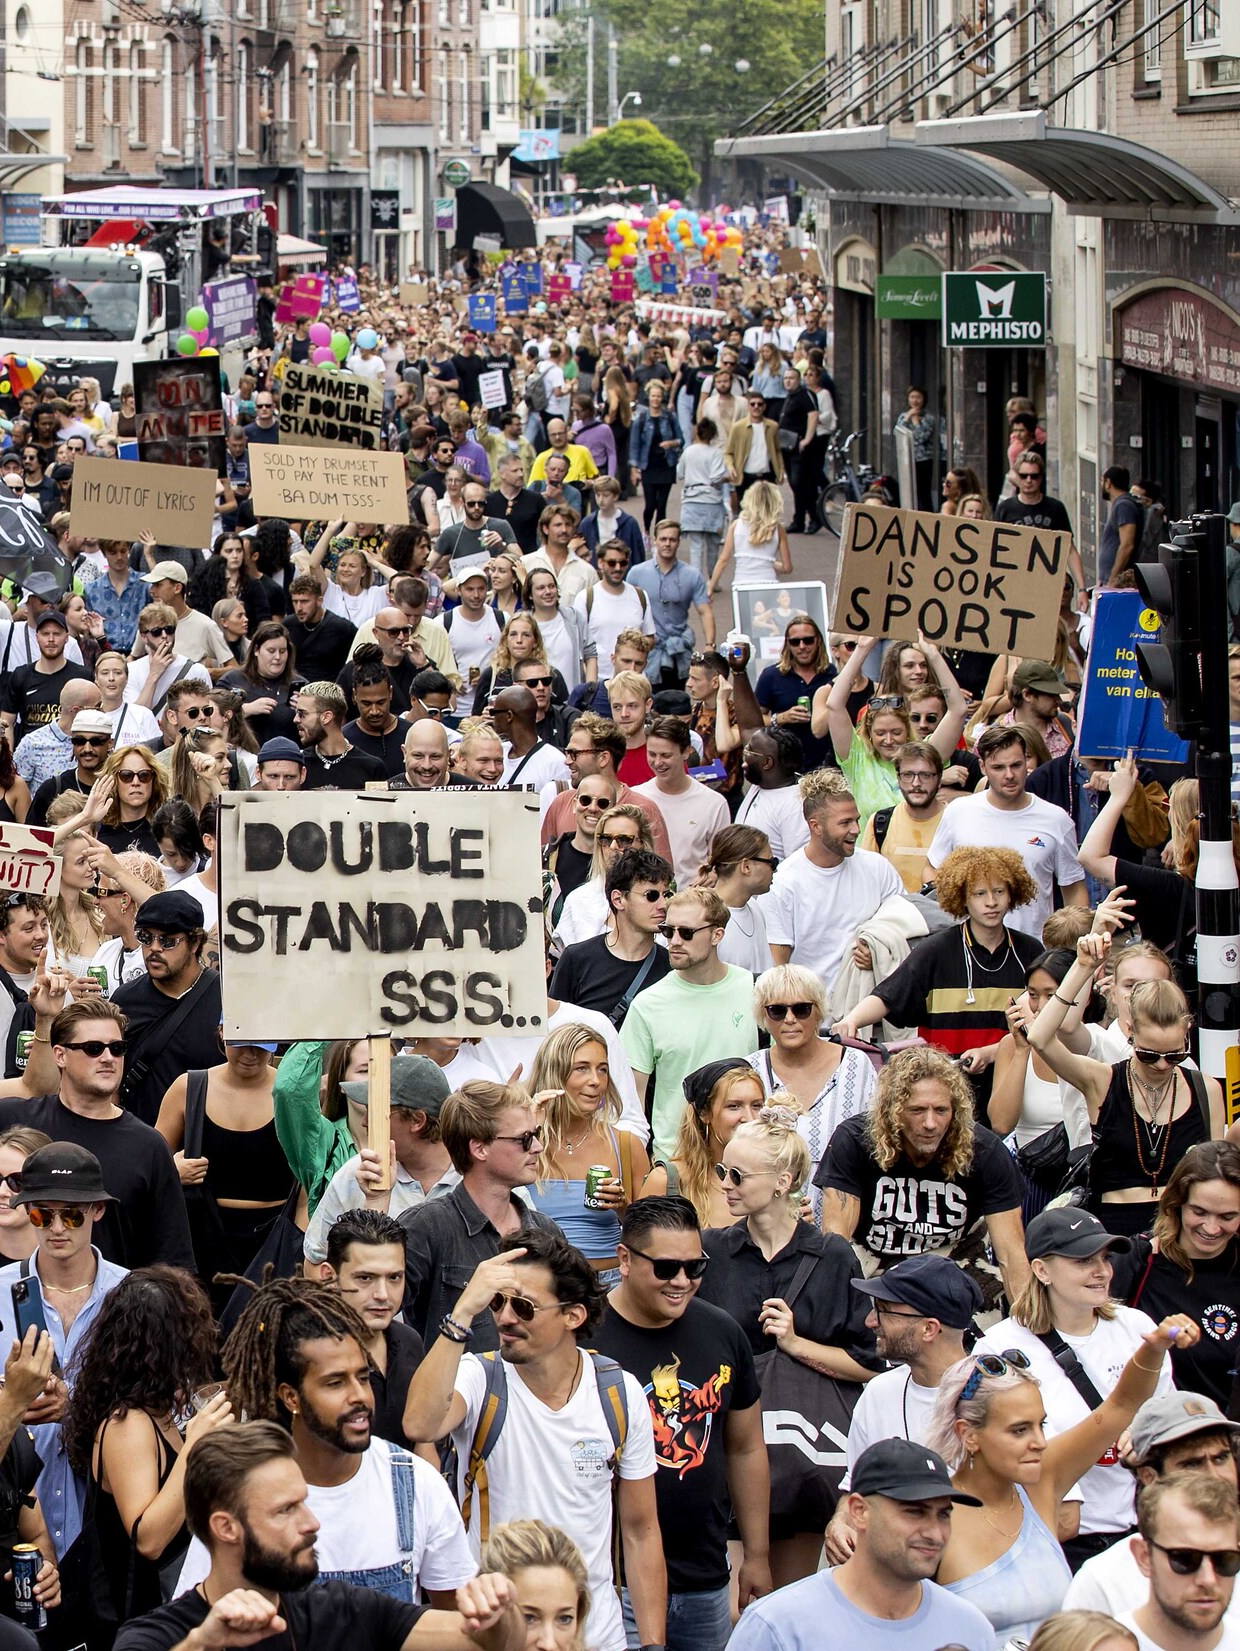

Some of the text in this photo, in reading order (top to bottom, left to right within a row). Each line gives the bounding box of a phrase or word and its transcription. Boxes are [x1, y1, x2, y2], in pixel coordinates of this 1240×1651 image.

[950, 321, 1043, 340] MEPHISTO
[286, 370, 370, 403] SUMMER
[281, 393, 382, 427] OF DOUBLE
[141, 412, 222, 441] MUTE
[264, 453, 379, 473] SOLD MY DRUMSET
[266, 469, 389, 488] TO PAY THE RENT
[84, 480, 100, 503] I'M
[107, 484, 133, 506] OUT
[134, 488, 151, 508] OF
[310, 491, 339, 506] DUM
[852, 512, 1062, 575] DANSEN
[887, 560, 1006, 601] IS OOK
[846, 587, 1036, 651] SPORT
[1097, 667, 1137, 679] meter
[1106, 686, 1131, 697] van
[244, 820, 485, 879] DOUBLE
[381, 970, 542, 1028] SSS...
[872, 1176, 968, 1227] GUTS
[866, 1224, 965, 1255] GLORY
[904, 1223, 933, 1235] AND
[1224, 1322, 1238, 1341] DISCO
[15, 1577, 32, 1600] 86
